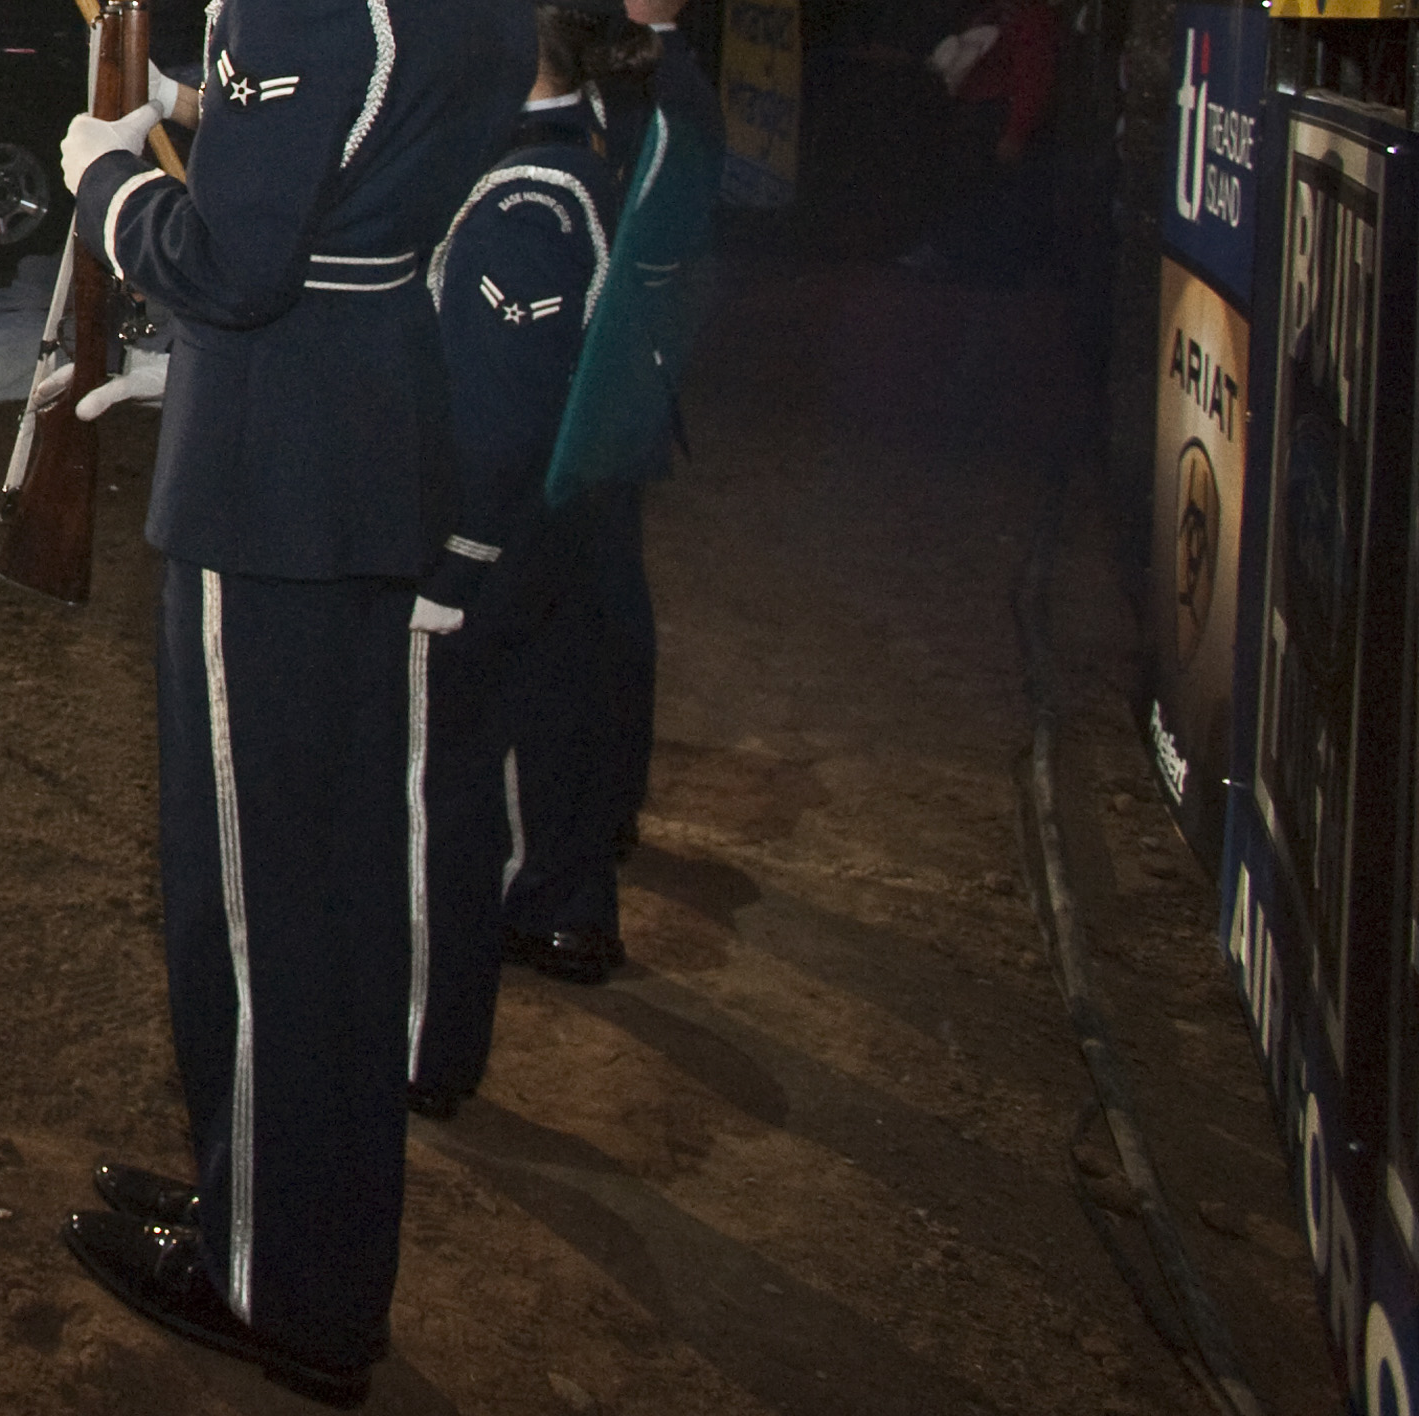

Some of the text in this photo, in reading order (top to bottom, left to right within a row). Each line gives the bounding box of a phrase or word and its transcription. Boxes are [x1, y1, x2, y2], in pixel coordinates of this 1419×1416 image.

[1207, 101, 1257, 171] TREASURE
[1204, 162, 1241, 229] ISLAND
[1169, 328, 1239, 443] ARIAT
